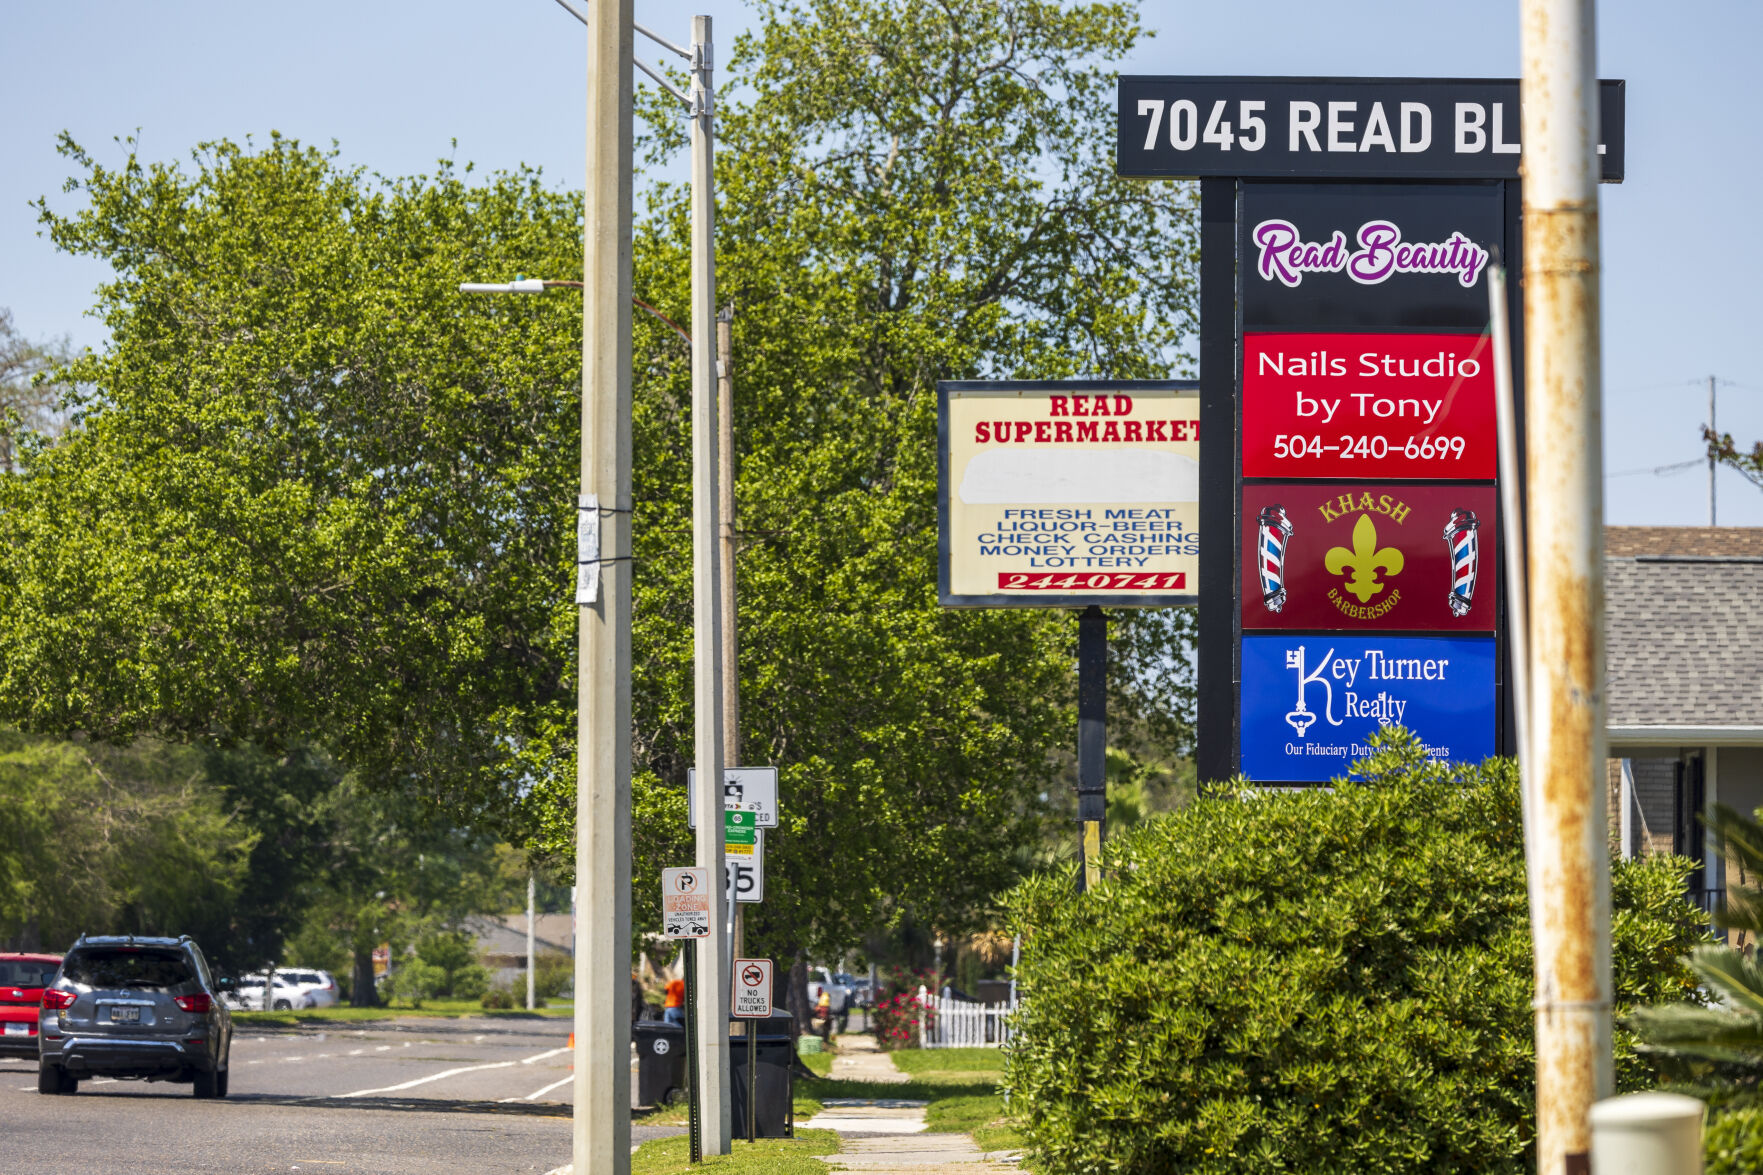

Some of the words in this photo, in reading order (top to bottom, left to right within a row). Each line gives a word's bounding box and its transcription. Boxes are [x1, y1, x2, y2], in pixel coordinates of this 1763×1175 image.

[1137, 99, 1266, 152] 7045
[1288, 101, 1432, 153] READ
[1255, 221, 1347, 285] Read
[1349, 222, 1485, 285] Beauty
[1259, 350, 1347, 377] Nails
[1359, 351, 1481, 378] Studio
[1049, 395, 1133, 417] READ
[1296, 391, 1341, 424] by
[1350, 392, 1443, 425] Tony
[1273, 434, 1466, 460] 504-240-6699
[1004, 509, 1092, 520] FRESH
[1105, 509, 1175, 519] MEAT
[1318, 491, 1412, 526] KHASH
[997, 521, 1183, 532] LIQUOR-BEER
[977, 533, 1069, 544] CHECK
[1083, 533, 1199, 544] CASHING
[980, 545, 1076, 556] MONEY
[1088, 545, 1199, 556] ORDERS
[1030, 556, 1149, 567] LOTTERY
[1005, 574, 1180, 589] 244-0741
[1326, 587, 1402, 620] BARBERSHOP
[1285, 645, 1361, 738] Key
[1364, 649, 1449, 681] Turner
[1344, 690, 1407, 726] Realty
[1285, 743, 1303, 756] Our
[1306, 743, 1348, 759] Fiduciary
[1350, 743, 1373, 760] Duty
[667, 895, 707, 904] LOADING
[675, 903, 700, 911] ZONE
[740, 997, 766, 1005] TRUCKS
[747, 989, 758, 997] NO
